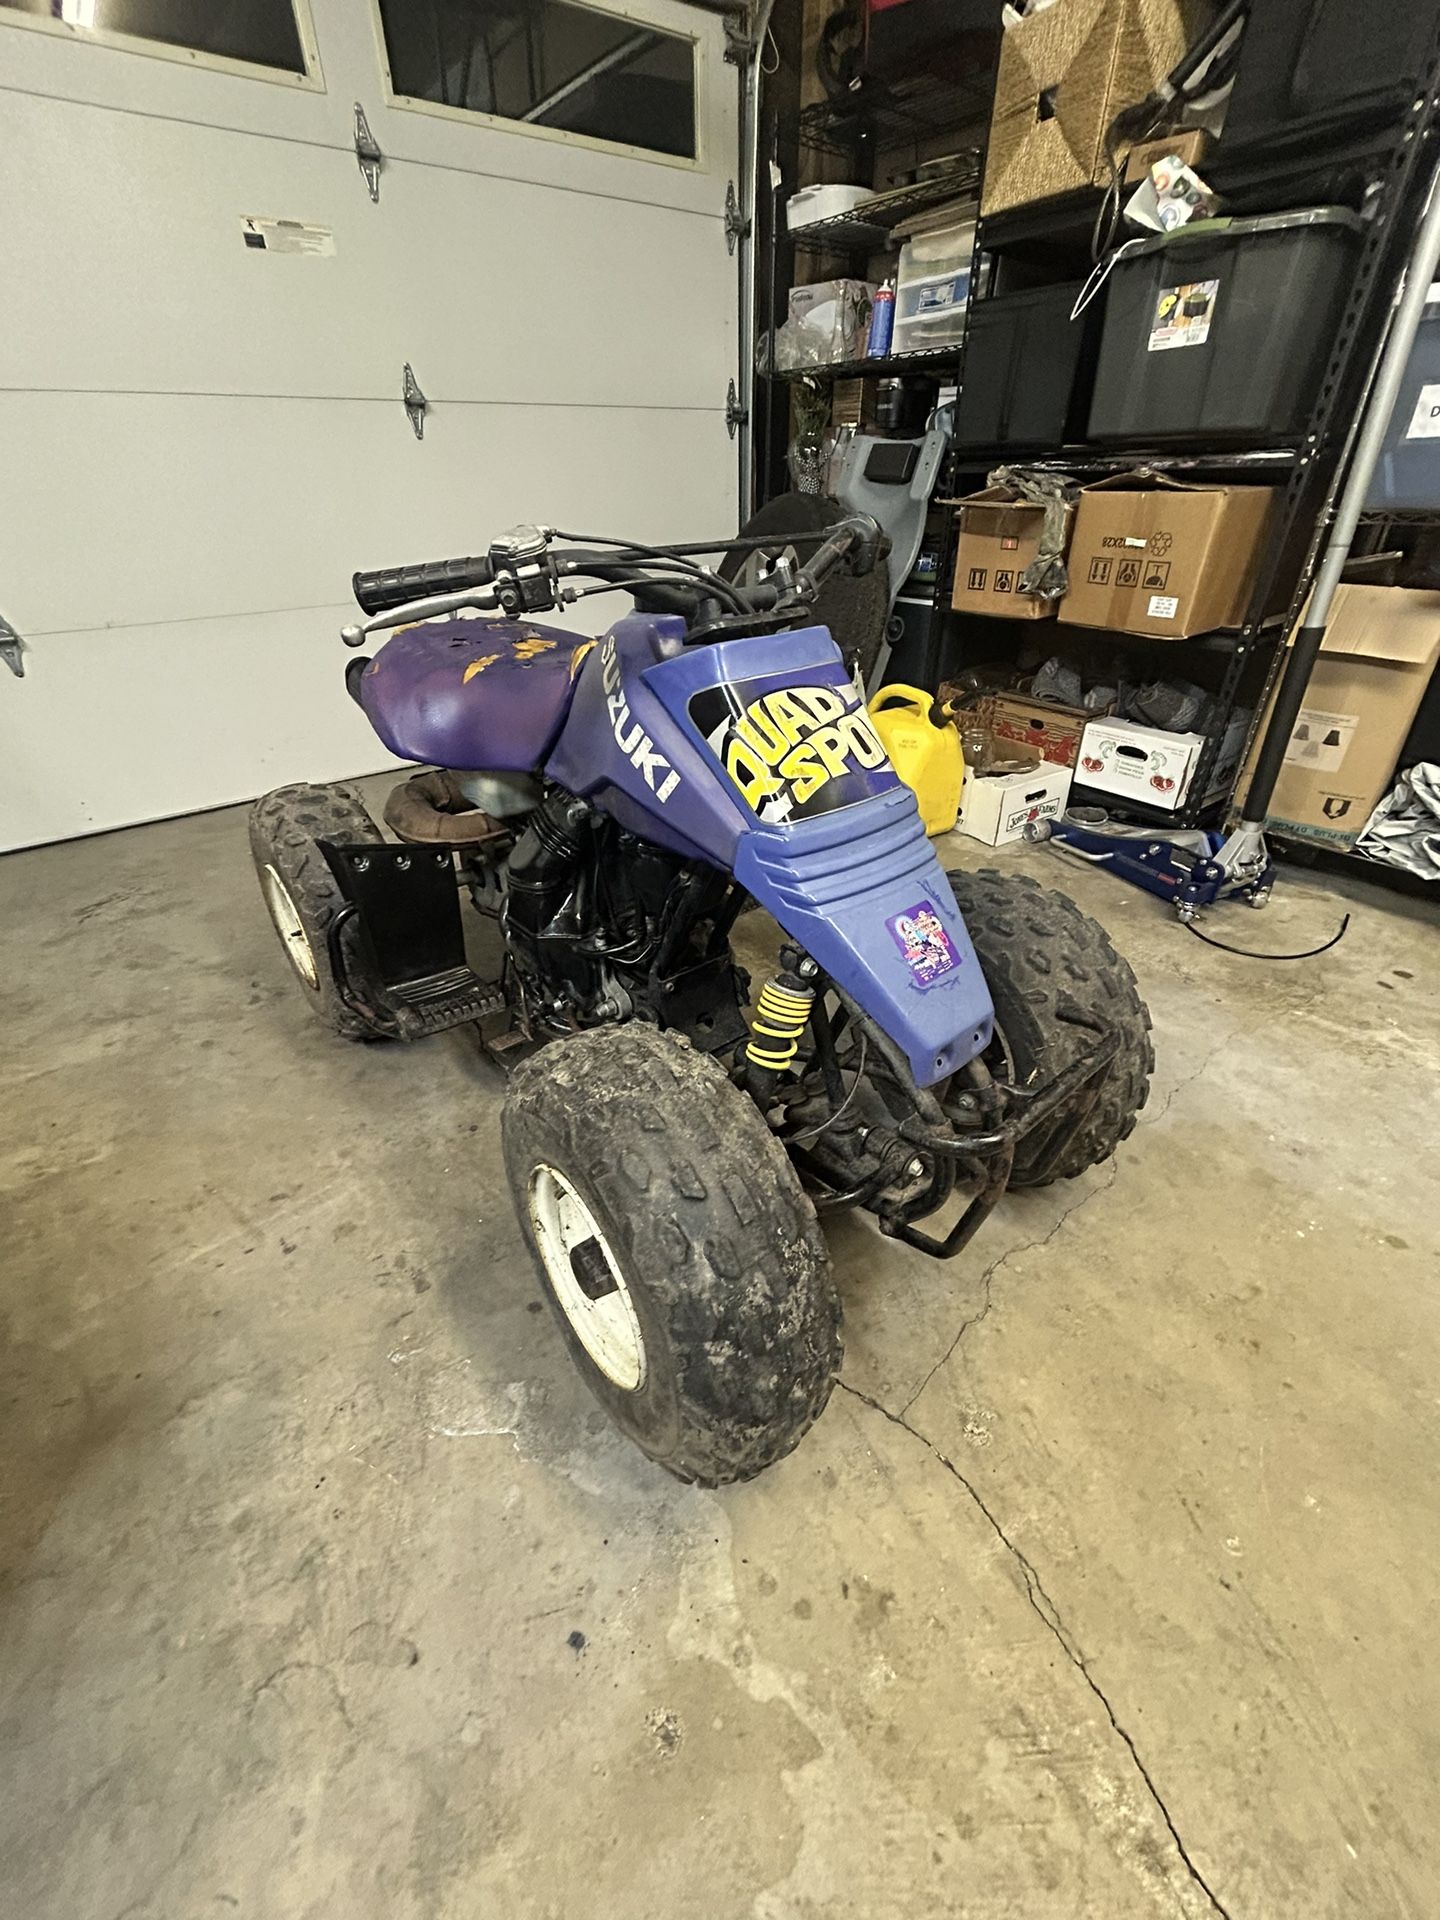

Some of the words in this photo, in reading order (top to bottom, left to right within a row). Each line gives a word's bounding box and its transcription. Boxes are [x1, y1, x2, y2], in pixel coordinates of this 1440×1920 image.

[600, 635, 681, 803] SUZUKI
[727, 686, 846, 811] QUAD
[778, 713, 886, 805] SPO
